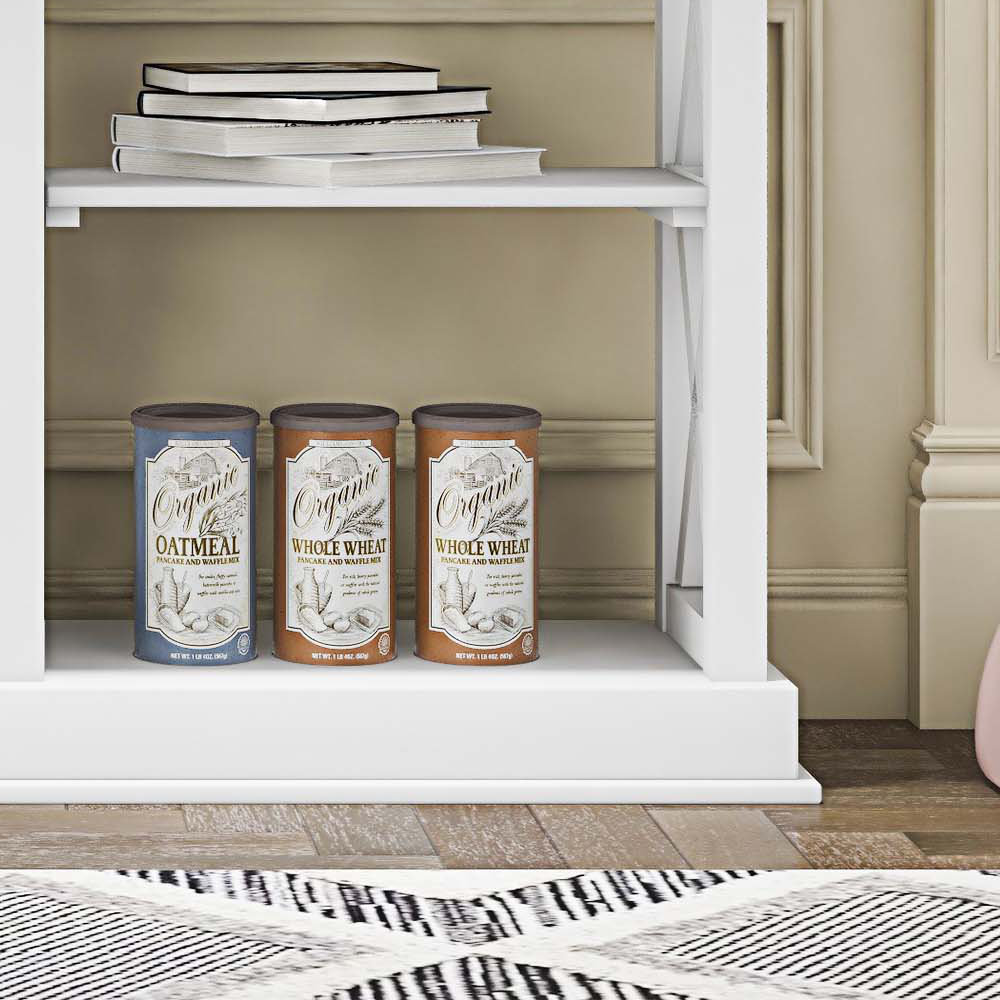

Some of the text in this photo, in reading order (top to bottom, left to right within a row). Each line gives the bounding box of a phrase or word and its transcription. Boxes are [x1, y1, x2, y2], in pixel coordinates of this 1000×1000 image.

[153, 464, 238, 533] Organic
[293, 464, 379, 533] Organic
[436, 464, 522, 533] Organic
[155, 535, 240, 556] OATMEAL
[292, 538, 387, 556] WHOLE WHEAT
[435, 538, 531, 556] WHOLE WHEAT
[156, 556, 240, 566] PANCAKE AND WAFFLE MIX
[297, 556, 326, 566] PANCAKE
[328, 558, 343, 566] AND
[344, 557, 369, 566] WAFFLE
[440, 556, 470, 566] PANCAKE
[472, 558, 487, 566] AND
[488, 557, 513, 566] WAFFLE
